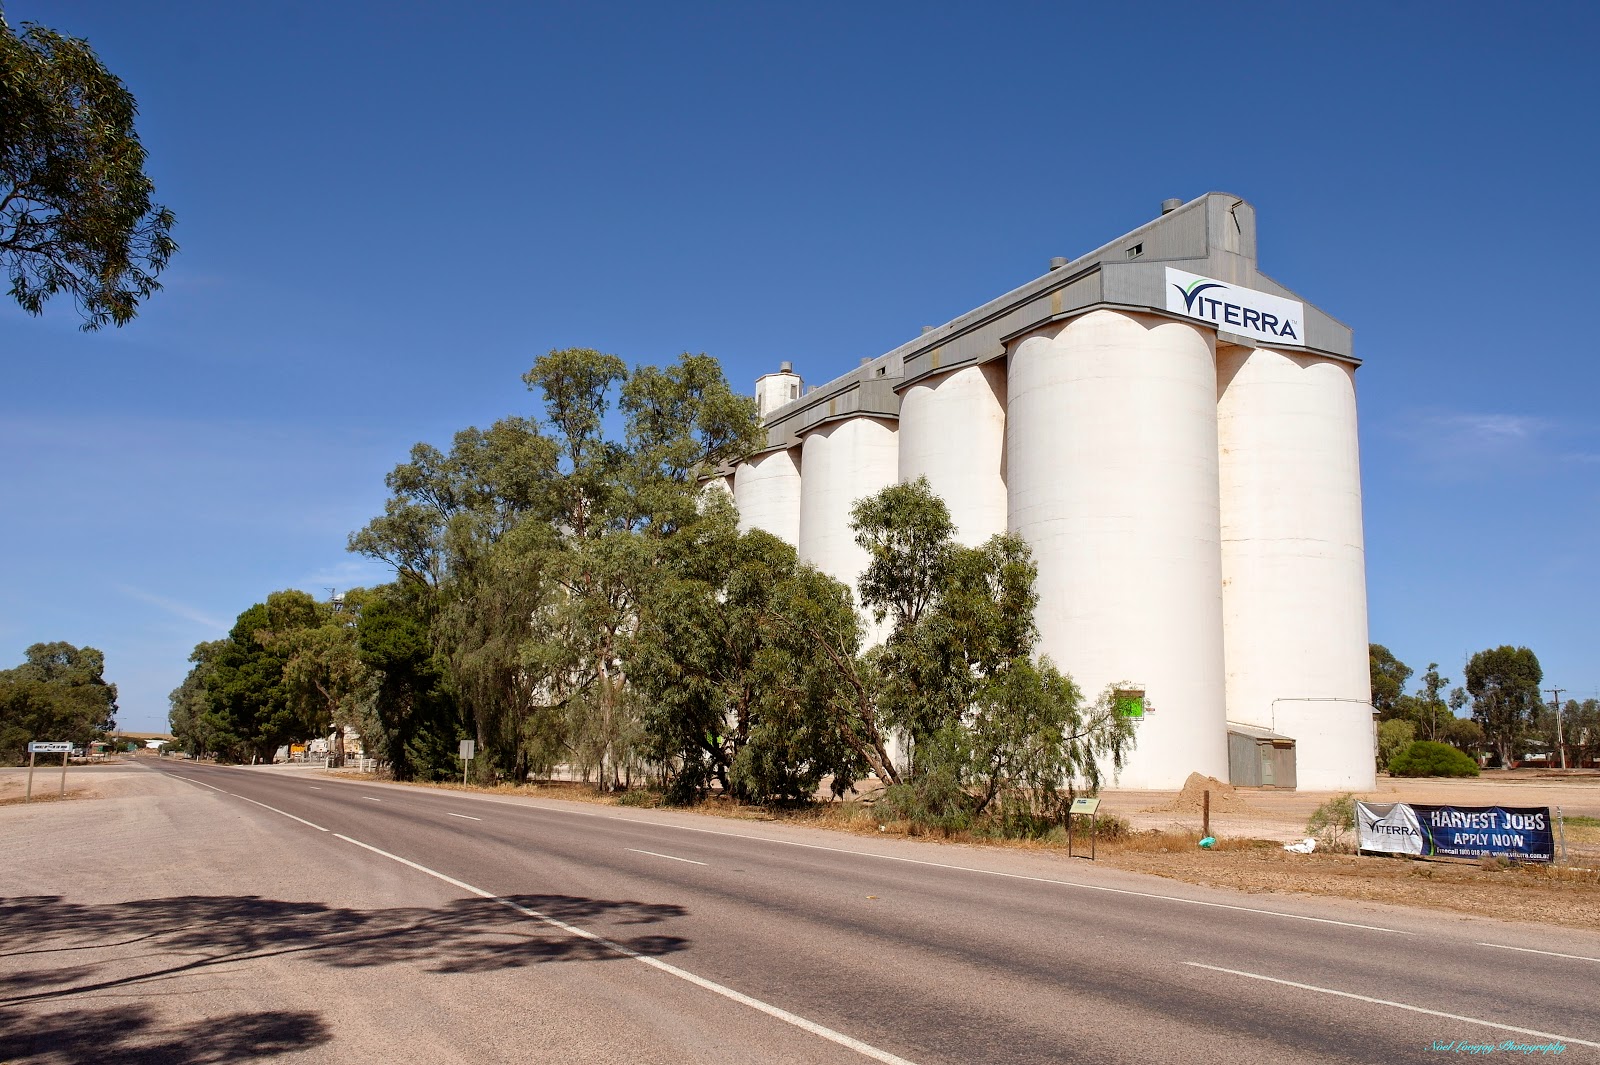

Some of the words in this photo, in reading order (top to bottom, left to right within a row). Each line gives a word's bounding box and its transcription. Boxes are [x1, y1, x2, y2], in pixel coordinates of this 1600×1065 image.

[1171, 282, 1298, 340] VITERRA
[1366, 818, 1419, 836] VITERRA
[1431, 811, 1497, 829] HARVEST
[1502, 812, 1545, 831] JOBS
[1454, 832, 1488, 845] APPLY
[1492, 834, 1524, 847] NOW
[1436, 847, 1459, 855] Freecall
